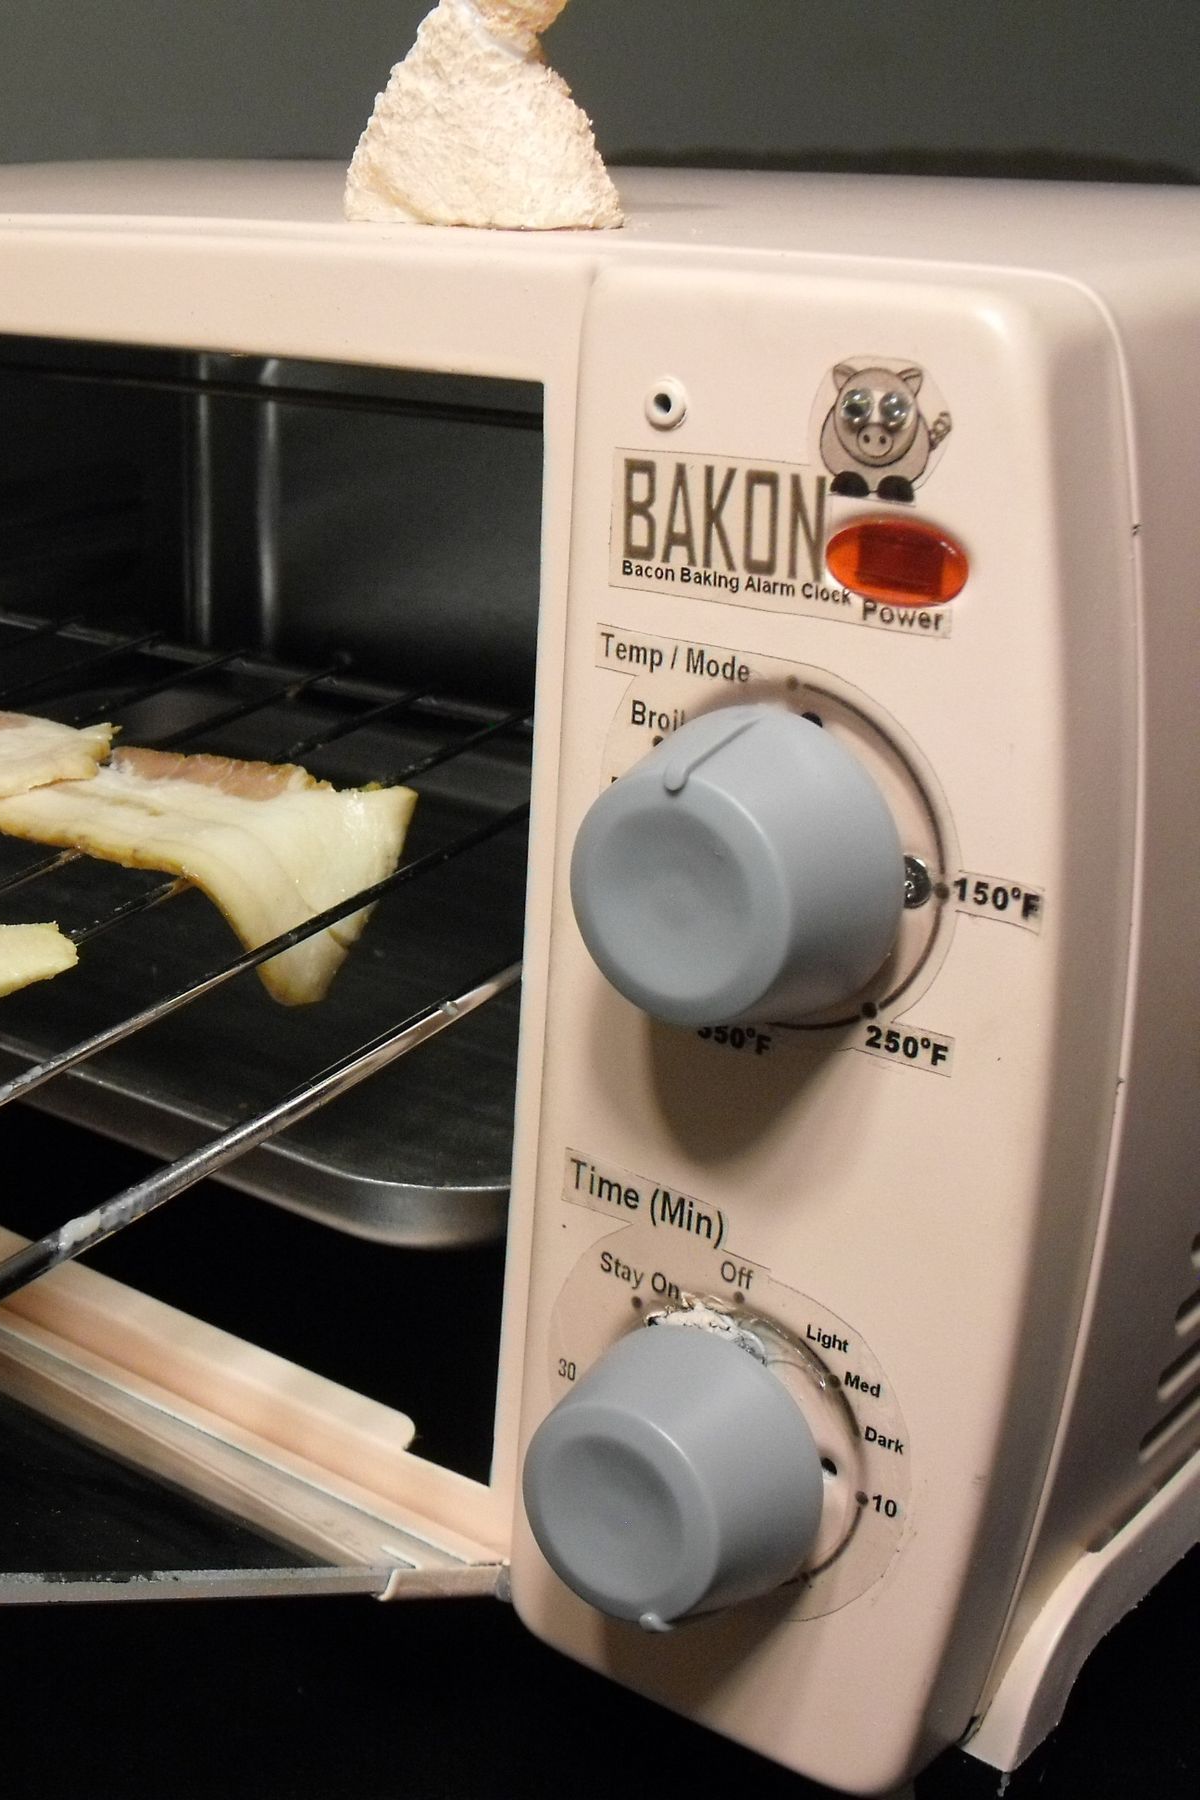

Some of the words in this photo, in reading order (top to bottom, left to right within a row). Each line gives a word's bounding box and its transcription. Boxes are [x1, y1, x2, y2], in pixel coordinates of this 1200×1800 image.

[623, 457, 826, 582] BAKON
[621, 560, 675, 582] Bacon
[680, 568, 740, 593] Baking
[744, 577, 795, 597] Alarm
[801, 583, 852, 607] Clock
[862, 601, 944, 631] Power
[601, 633, 663, 673] Temp
[686, 649, 750, 682] Mode
[954, 877, 1041, 920] 150°F
[865, 1025, 950, 1068] 250°F
[570, 1158, 640, 1211] Time
[650, 1188, 726, 1249] (Min)
[601, 1251, 644, 1289] Stay
[651, 1272, 681, 1301] On
[721, 1260, 754, 1290] Off
[806, 1323, 850, 1354] Light
[557, 1357, 577, 1382] 30
[844, 1371, 881, 1399] Med
[864, 1426, 905, 1455] Dark
[872, 1494, 898, 1519] 10
